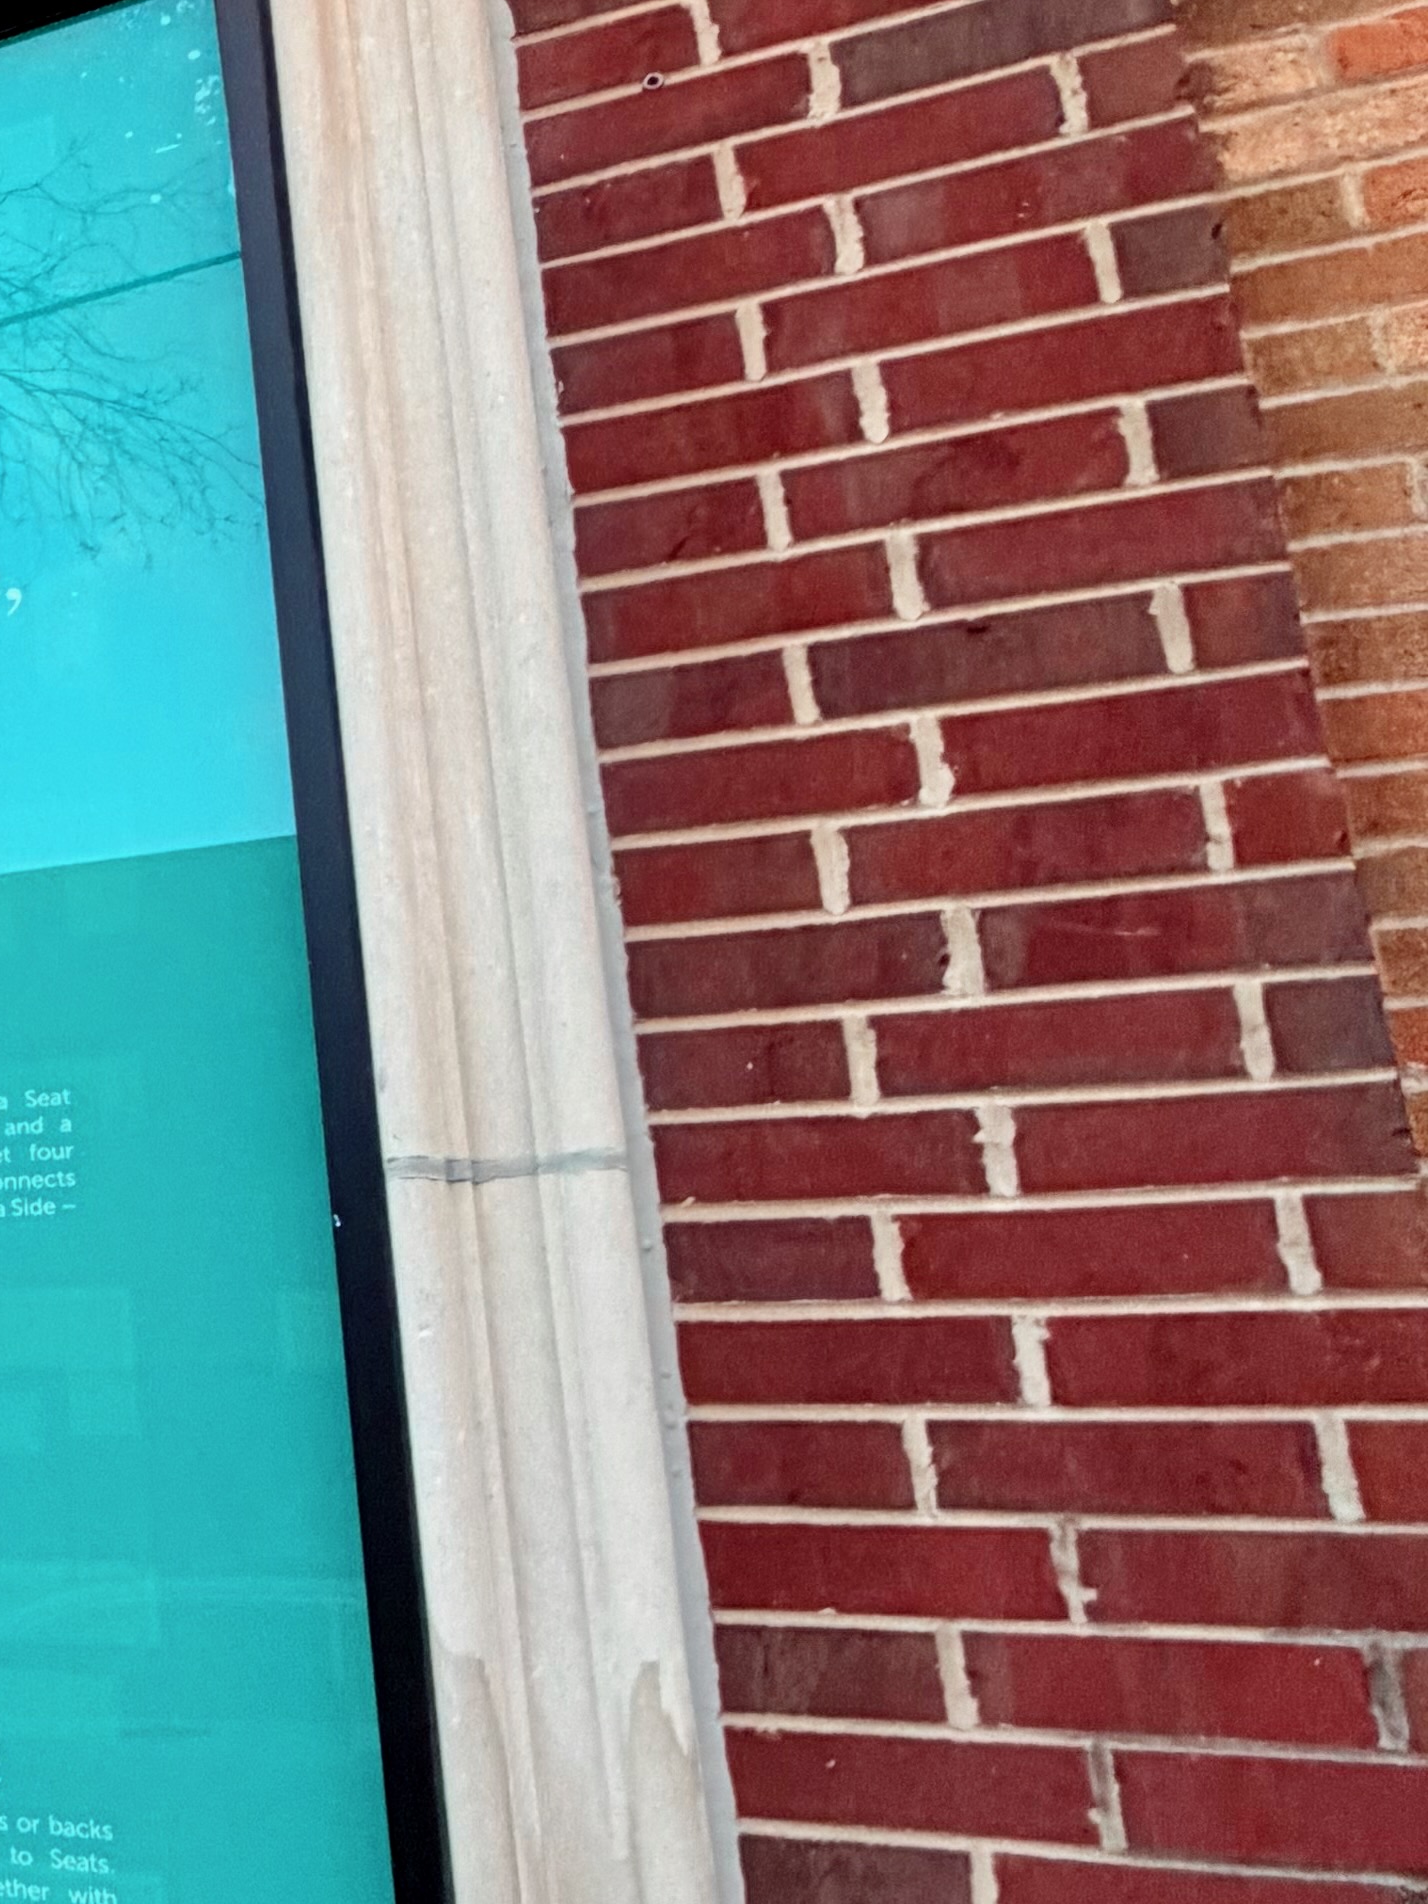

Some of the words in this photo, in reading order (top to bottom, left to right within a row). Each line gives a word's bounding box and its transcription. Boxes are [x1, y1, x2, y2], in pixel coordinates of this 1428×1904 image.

[24, 1089, 71, 1107] Seat
[4, 1116, 43, 1136] and
[60, 1118, 72, 1132] a
[29, 1144, 74, 1161] four
[11, 1198, 56, 1216] Side
[16, 1817, 39, 1834] or
[49, 1815, 113, 1841] backs
[10, 1847, 33, 1866] to
[49, 1848, 115, 1875] Seats.
